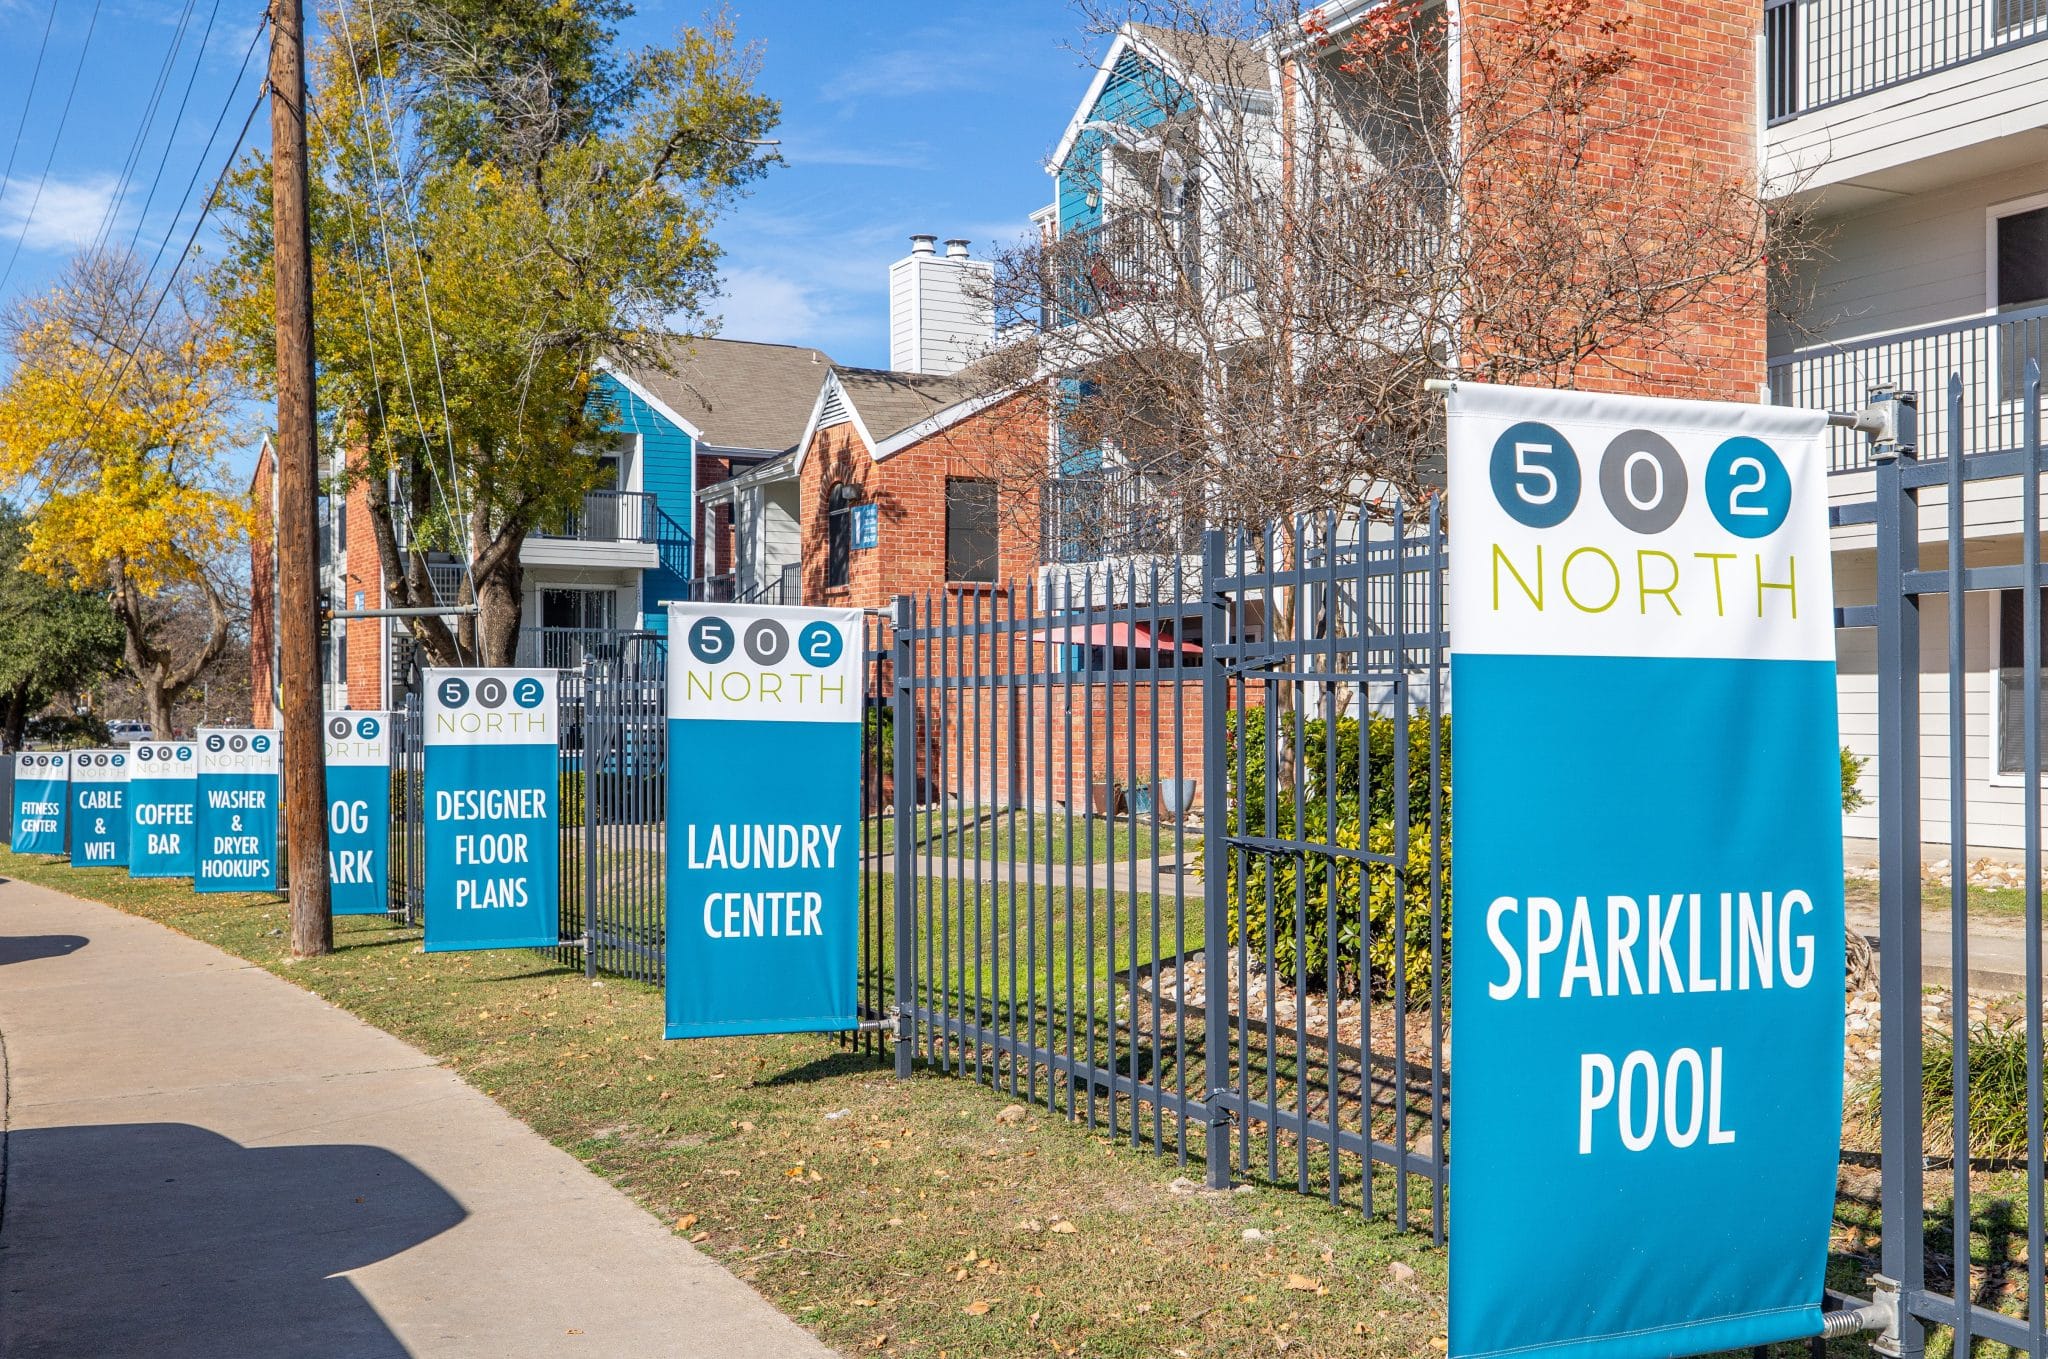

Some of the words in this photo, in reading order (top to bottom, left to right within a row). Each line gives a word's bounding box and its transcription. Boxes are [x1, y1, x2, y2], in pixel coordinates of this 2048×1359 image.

[1492, 543, 1797, 619] NORTH
[688, 670, 844, 704] NORTH
[437, 712, 545, 733] NORTH
[325, 742, 381, 758] ORTH
[137, 763, 193, 774] NORTH
[205, 755, 271, 768] NORTH
[21, 801, 59, 816] FITNESS
[79, 790, 122, 809] CABLE
[208, 790, 266, 809] WASHER
[436, 789, 547, 821] DESIGNER
[135, 803, 193, 825] COFFEE
[231, 814, 243, 832] &
[327, 800, 369, 834] OG
[21, 818, 57, 833] CENTER
[94, 817, 106, 834] &
[84, 841, 115, 860] WIFI
[148, 833, 180, 855] BAR
[213, 836, 259, 855] DRYER
[455, 833, 529, 865] FLOOR
[688, 824, 842, 870] LAUNDRY
[202, 859, 270, 878] HOOKUPS
[329, 850, 373, 884] ARK
[456, 877, 528, 910] PLANS
[703, 891, 823, 939] CENTER
[1487, 889, 1815, 1001] SPARKLING
[1579, 1046, 1736, 1155] POOL
